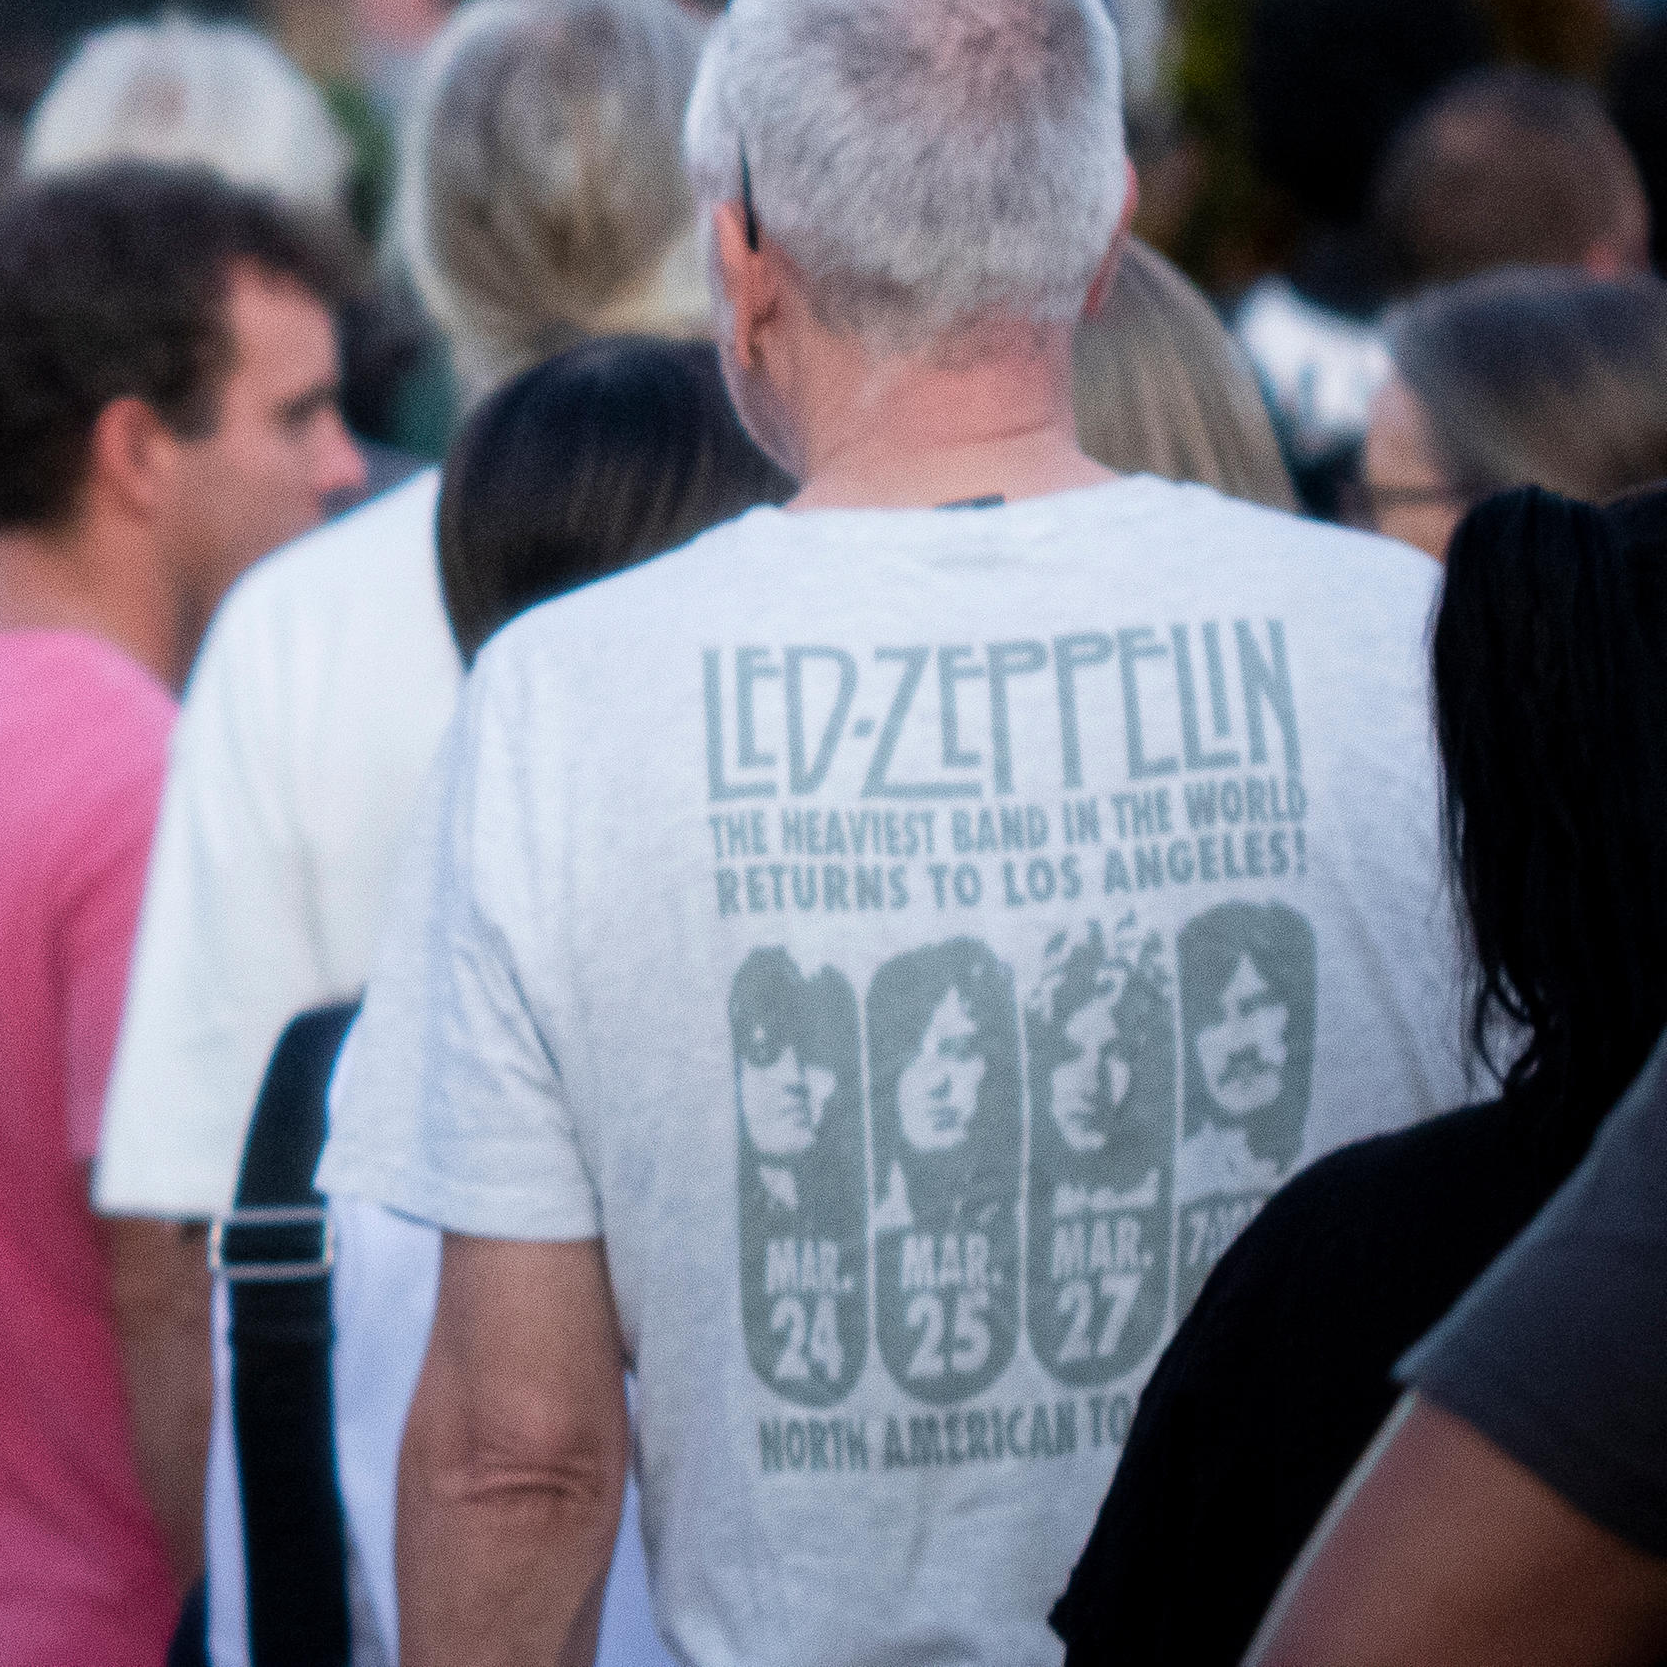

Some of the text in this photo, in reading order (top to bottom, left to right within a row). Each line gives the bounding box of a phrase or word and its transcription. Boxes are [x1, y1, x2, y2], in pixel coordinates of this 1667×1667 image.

[709, 775, 1309, 858] THE HEAVIEST BAND IN THE WORLD
[716, 827, 1308, 918] RETURNS TO LOS ANGELES!
[765, 1236, 854, 1294] MAR.
[900, 1232, 1003, 1290] MAR.
[1051, 1216, 1155, 1279] MAR.
[770, 1296, 844, 1382] 24
[905, 1287, 993, 1380] 25
[1058, 1272, 1143, 1362] 27
[760, 1393, 1134, 1471] NORTH AMERICAN TO
